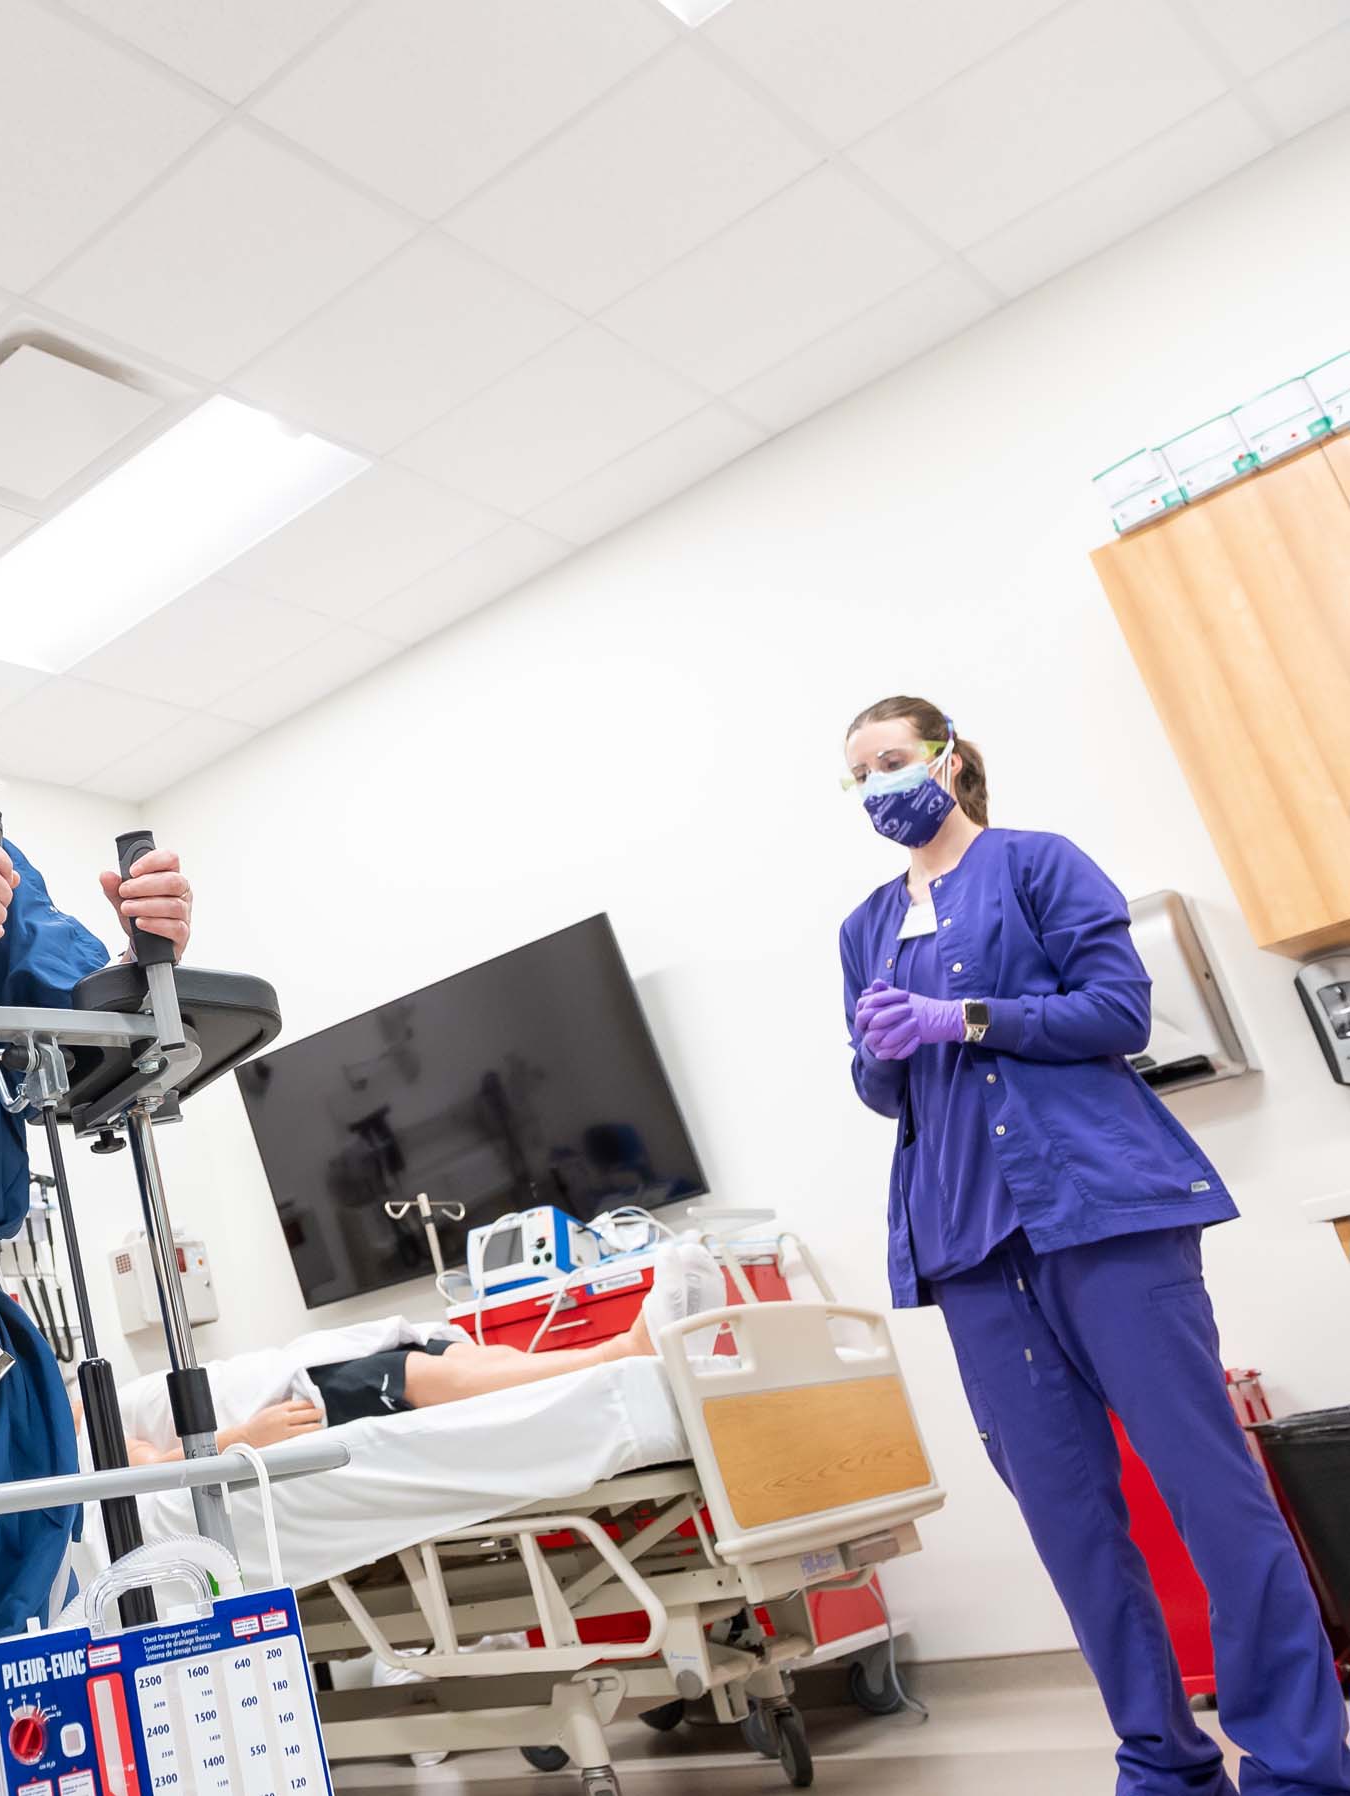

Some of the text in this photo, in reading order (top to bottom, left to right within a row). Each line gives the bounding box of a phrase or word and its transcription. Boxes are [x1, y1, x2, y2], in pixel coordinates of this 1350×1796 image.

[143, 1628, 199, 1645] Chest Drainage System
[173, 1637, 195, 1647] drainage
[195, 1632, 221, 1642] thoracique
[145, 1653, 165, 1662] Sistema
[173, 1646, 191, 1656] drenaje
[266, 1648, 282, 1660] 200
[1, 1648, 87, 1690] PLEUR-EVAC
[234, 1658, 251, 1670] 640
[187, 1665, 209, 1679] 1600
[139, 1675, 162, 1689] 2500
[272, 1680, 288, 1691] 180
[241, 1696, 258, 1708] 600
[195, 1710, 217, 1724] 1500
[278, 1712, 294, 1724] 160
[147, 1724, 170, 1738] 2400
[250, 1744, 267, 1757] 550
[285, 1744, 300, 1756] 140
[202, 1755, 225, 1768] 1400
[154, 1773, 178, 1788] 2300
[291, 1777, 306, 1789] 120
